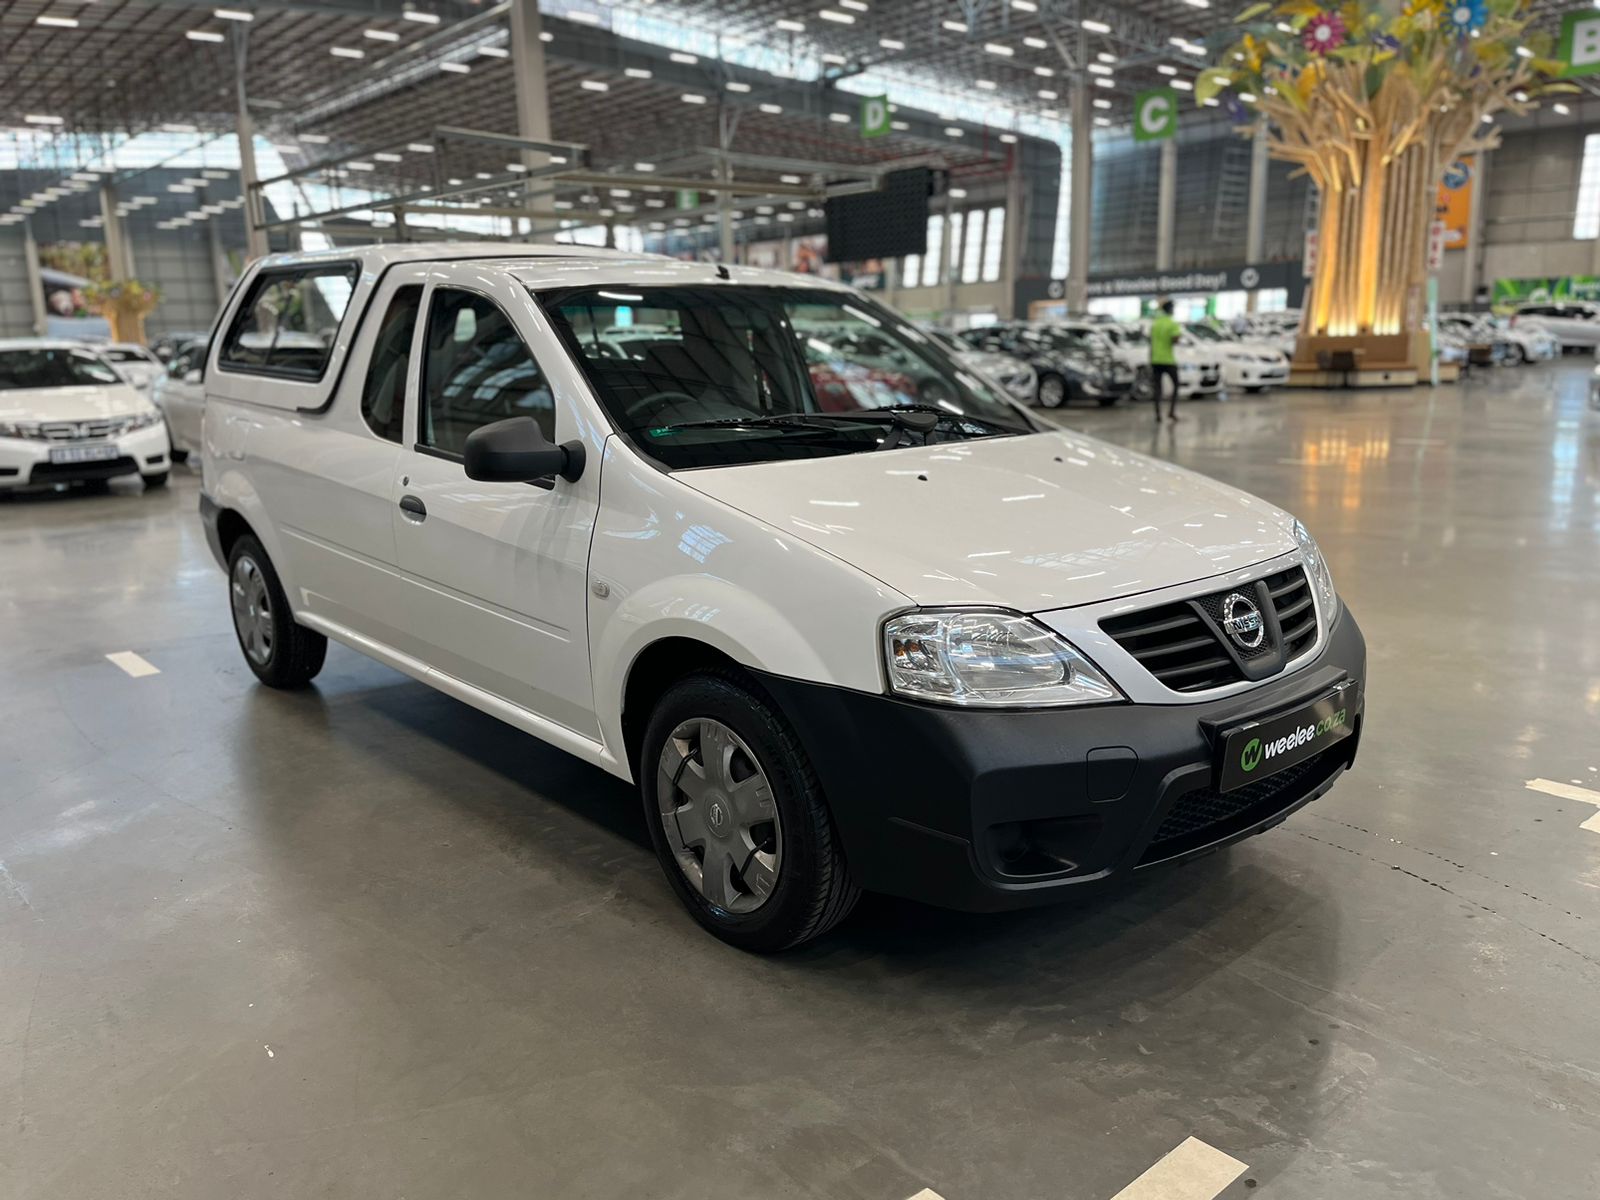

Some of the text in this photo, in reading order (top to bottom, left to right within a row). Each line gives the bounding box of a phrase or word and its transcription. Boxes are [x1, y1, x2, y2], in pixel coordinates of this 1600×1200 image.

[1571, 19, 1600, 67] B
[866, 101, 884, 129] D
[1141, 96, 1168, 132] C
[1231, 612, 1262, 631] NISS
[1265, 708, 1346, 760] weelee.co.za
